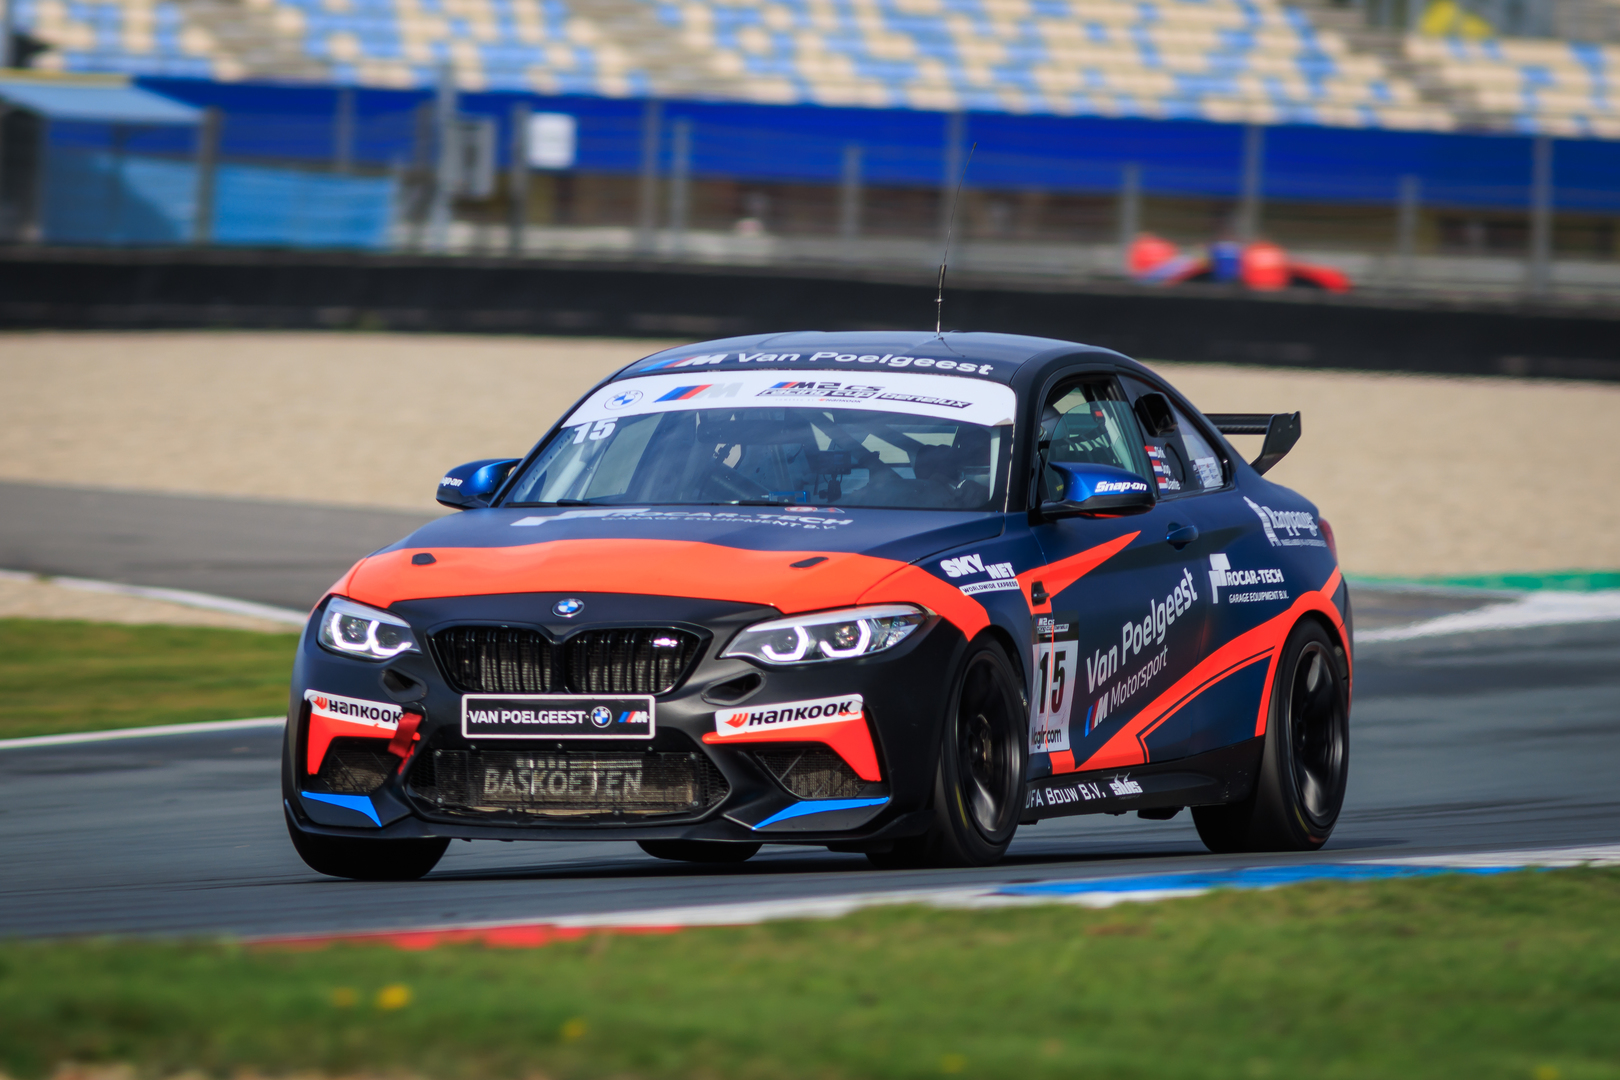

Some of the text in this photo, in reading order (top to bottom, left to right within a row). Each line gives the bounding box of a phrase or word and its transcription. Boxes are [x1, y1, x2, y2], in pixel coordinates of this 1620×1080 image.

[738, 352, 800, 364] Van
[809, 351, 994, 375] Poelgeest
[572, 417, 619, 445] 15
[1094, 481, 1147, 493] Snap-on
[963, 580, 1019, 594] WORLDWIDE EXPRESS
[1228, 593, 1250, 604] GARAGE
[1249, 590, 1279, 602] EQUIPMENT
[1086, 567, 1198, 694] Van Poelgeest
[1039, 650, 1067, 715] 15
[1110, 644, 1168, 713] Motorsport
[468, 710, 499, 724] VAN
[501, 710, 586, 724] POELGEEST
